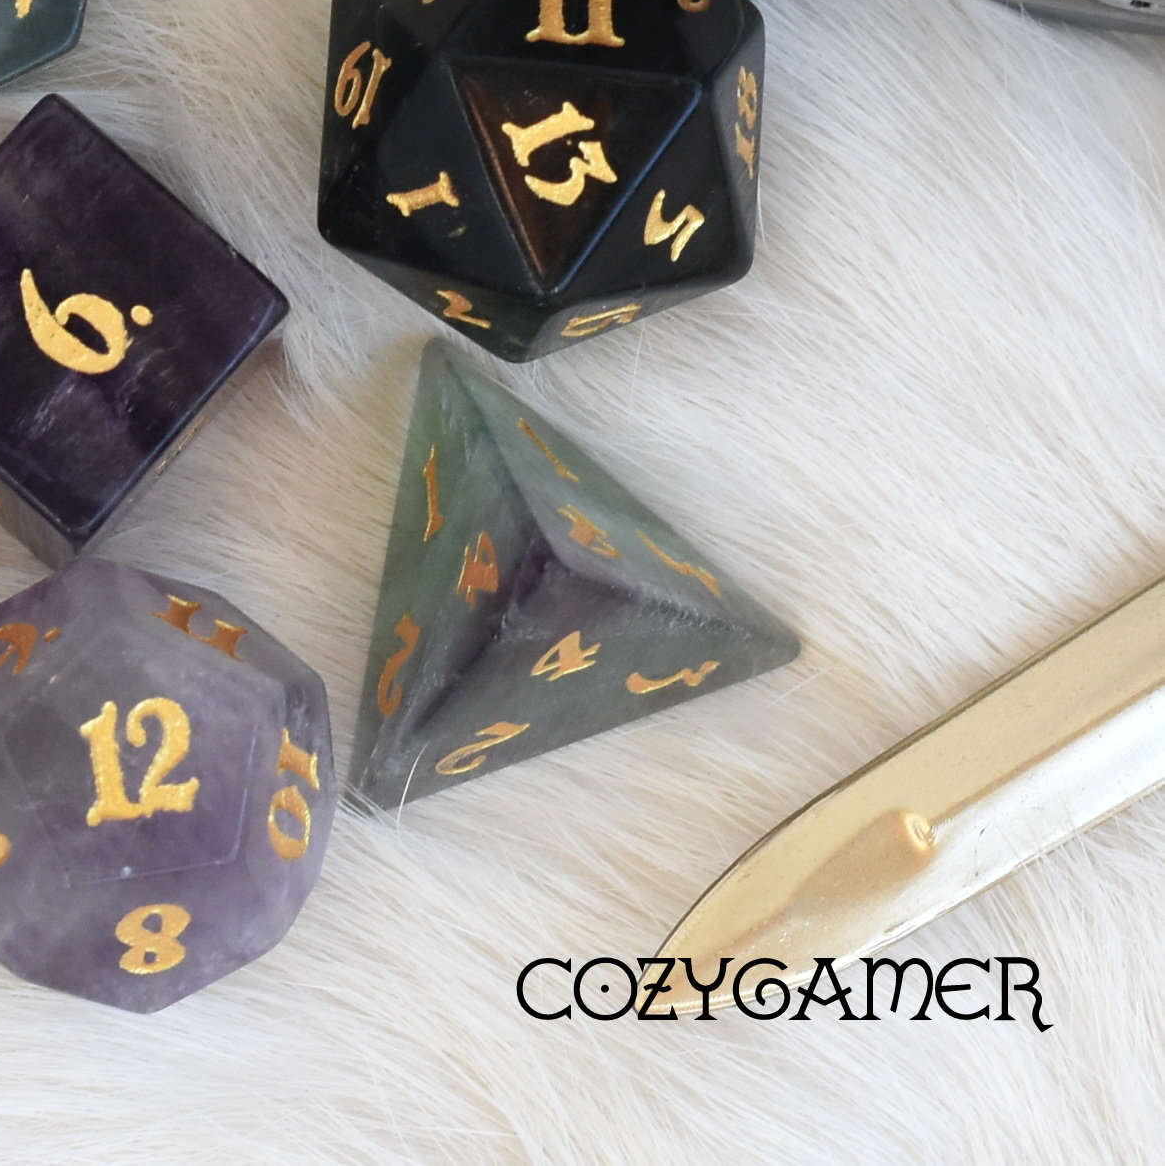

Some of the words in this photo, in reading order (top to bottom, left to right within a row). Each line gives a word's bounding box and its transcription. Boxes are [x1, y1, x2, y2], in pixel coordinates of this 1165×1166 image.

[333, 40, 393, 130] 19
[735, 66, 758, 179] 18
[386, 170, 461, 218] 1
[499, 99, 619, 208] 13
[644, 190, 705, 261] 5
[421, 443, 446, 544] 1
[456, 531, 501, 607] 4
[151, 595, 249, 662] 11
[532, 631, 601, 680] 4
[81, 697, 200, 827] 12
[268, 728, 320, 861] 10
[116, 904, 191, 973] 8
